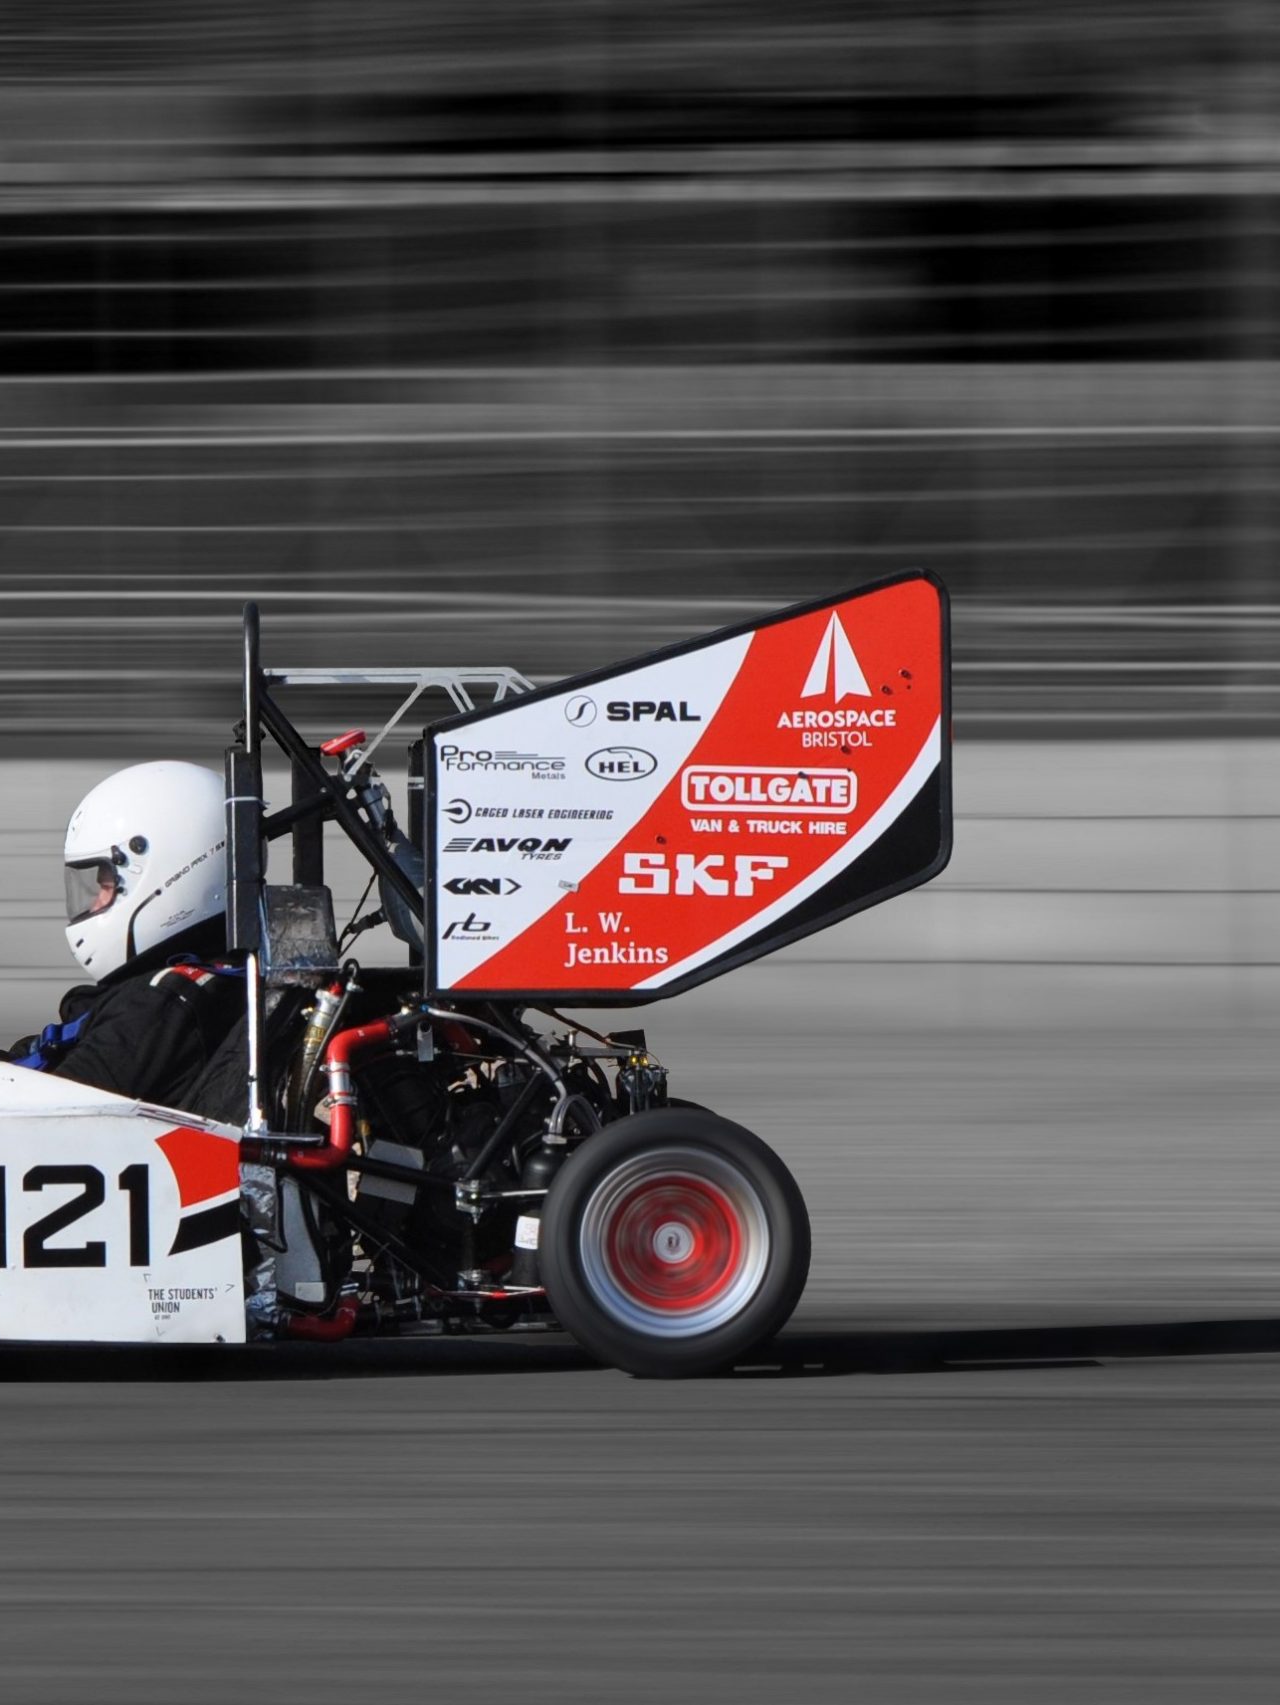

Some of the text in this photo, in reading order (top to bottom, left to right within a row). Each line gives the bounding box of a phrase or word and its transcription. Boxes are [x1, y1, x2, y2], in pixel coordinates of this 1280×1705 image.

[606, 701, 702, 722] SPAL
[777, 709, 897, 729] AEROSPACE
[802, 730, 872, 748] BRISTOL
[440, 745, 492, 762] Pro
[598, 761, 646, 773] HEL
[531, 772, 566, 780] Metals
[690, 775, 848, 804] TOLLGATE
[512, 808, 543, 819] LASER
[690, 819, 847, 835] VAN & TRUCK HIRE
[471, 838, 573, 852] AVON
[520, 853, 563, 861] TYRES
[618, 853, 789, 897] SKF
[565, 912, 631, 933] L. W.
[564, 942, 669, 968] Jenkins
[148, 1289, 165, 1300] THE
[151, 1302, 180, 1313] UNION
